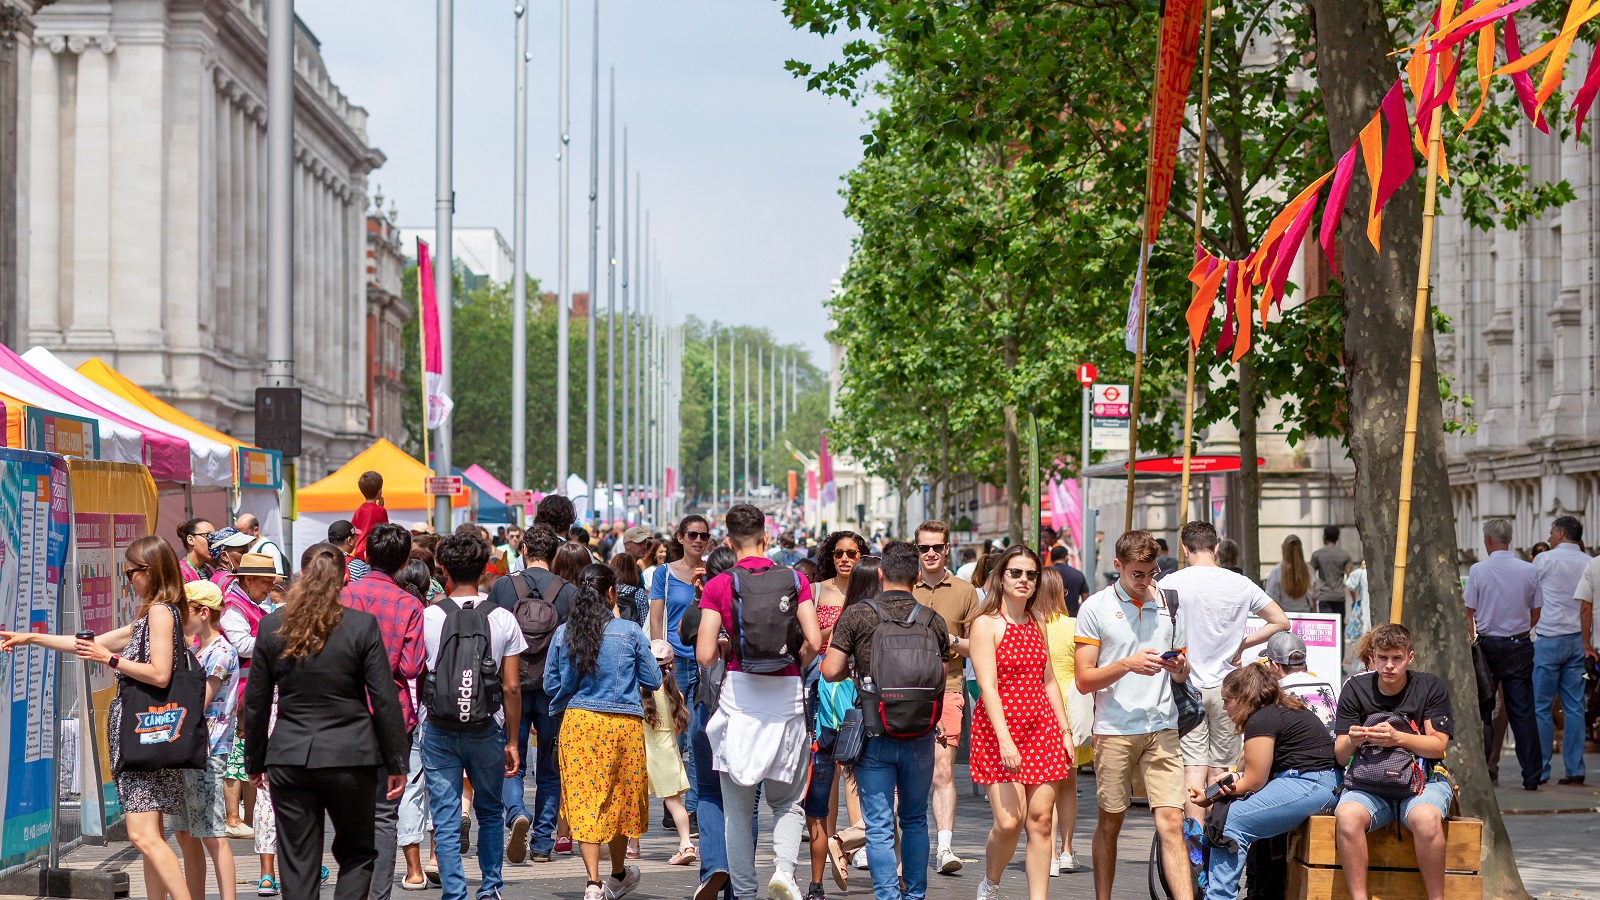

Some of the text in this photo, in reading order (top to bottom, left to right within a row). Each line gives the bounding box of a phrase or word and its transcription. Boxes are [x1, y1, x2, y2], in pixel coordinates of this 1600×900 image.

[1081, 366, 1092, 382] L
[458, 669, 473, 723] adidas
[144, 712, 176, 726] CANNES
